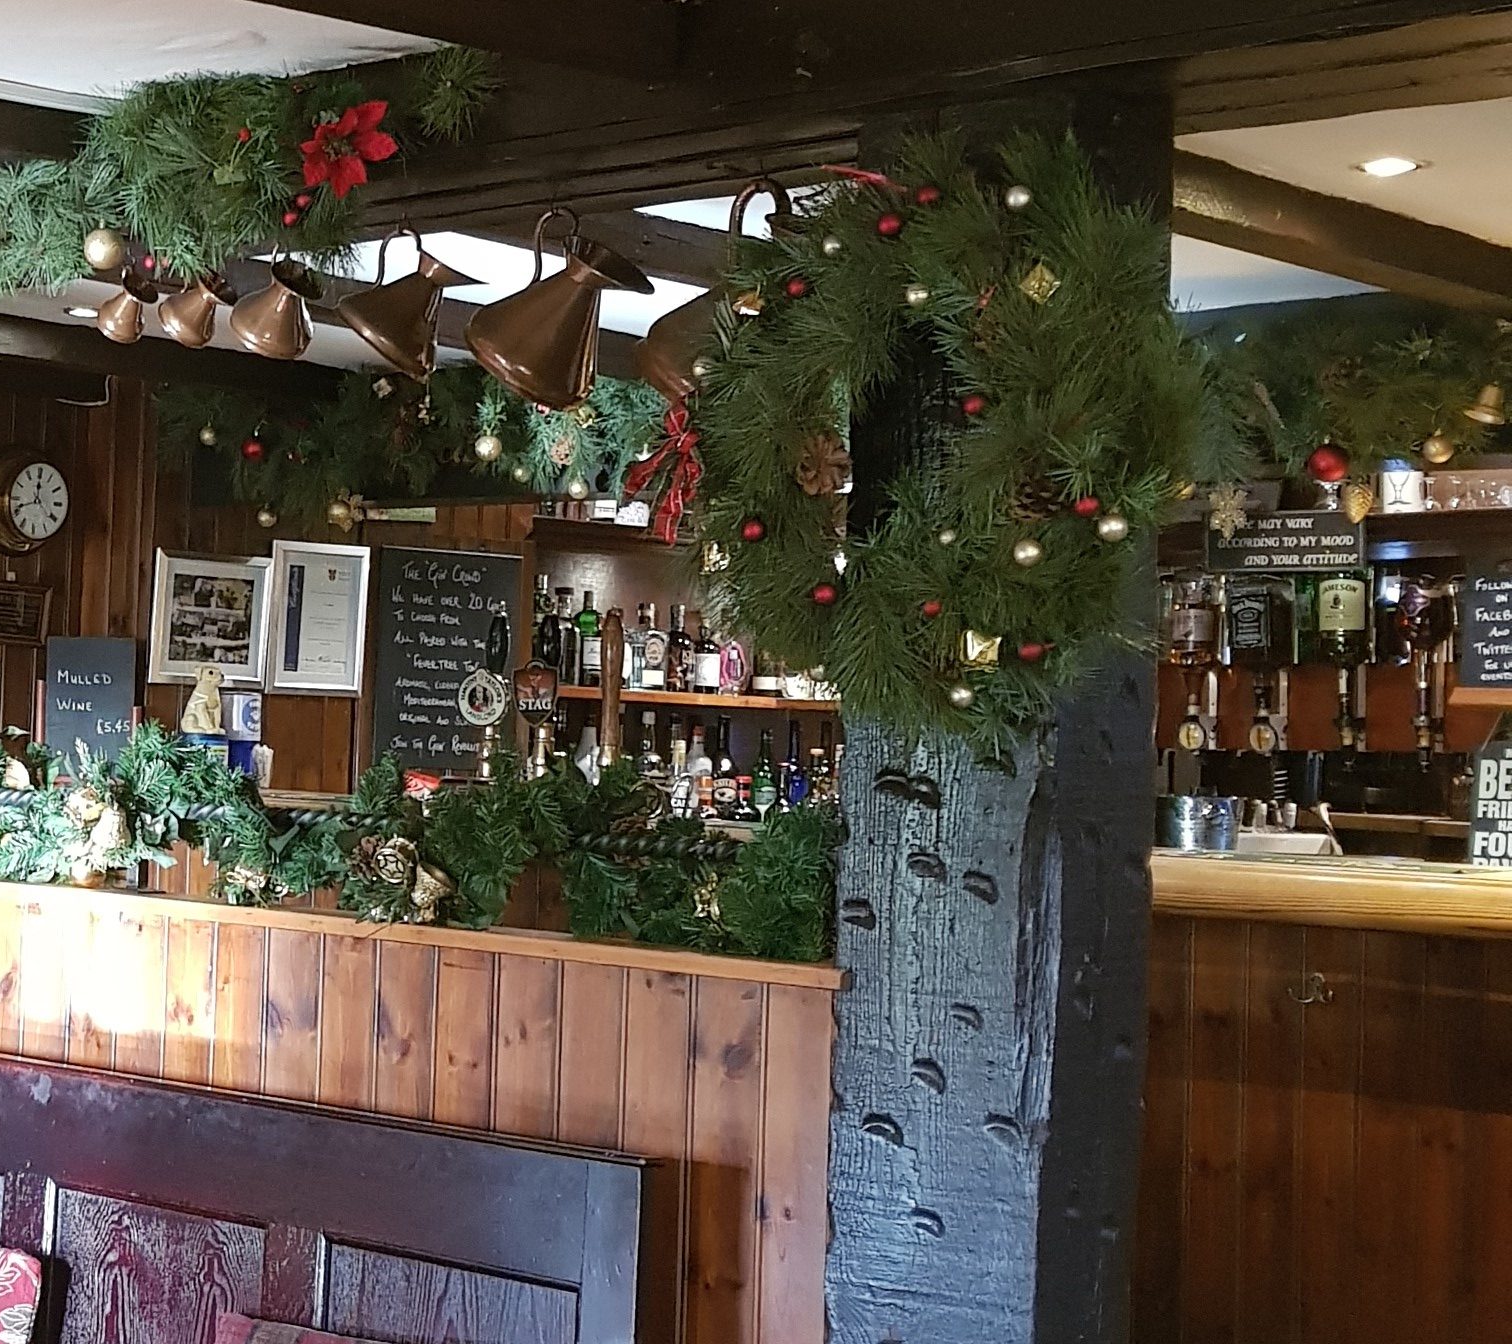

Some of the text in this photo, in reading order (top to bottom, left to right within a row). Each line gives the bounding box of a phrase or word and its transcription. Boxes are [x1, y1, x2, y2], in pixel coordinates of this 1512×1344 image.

[1282, 536, 1298, 548] TO
[1300, 536, 1320, 547] MY
[1321, 535, 1354, 546] MOOD
[1321, 582, 1359, 596] JAMESON
[468, 592, 483, 610] 20
[56, 668, 113, 686] MULLED
[56, 697, 93, 712] WINE
[518, 698, 552, 711] STAG
[96, 718, 131, 735] £5.45
